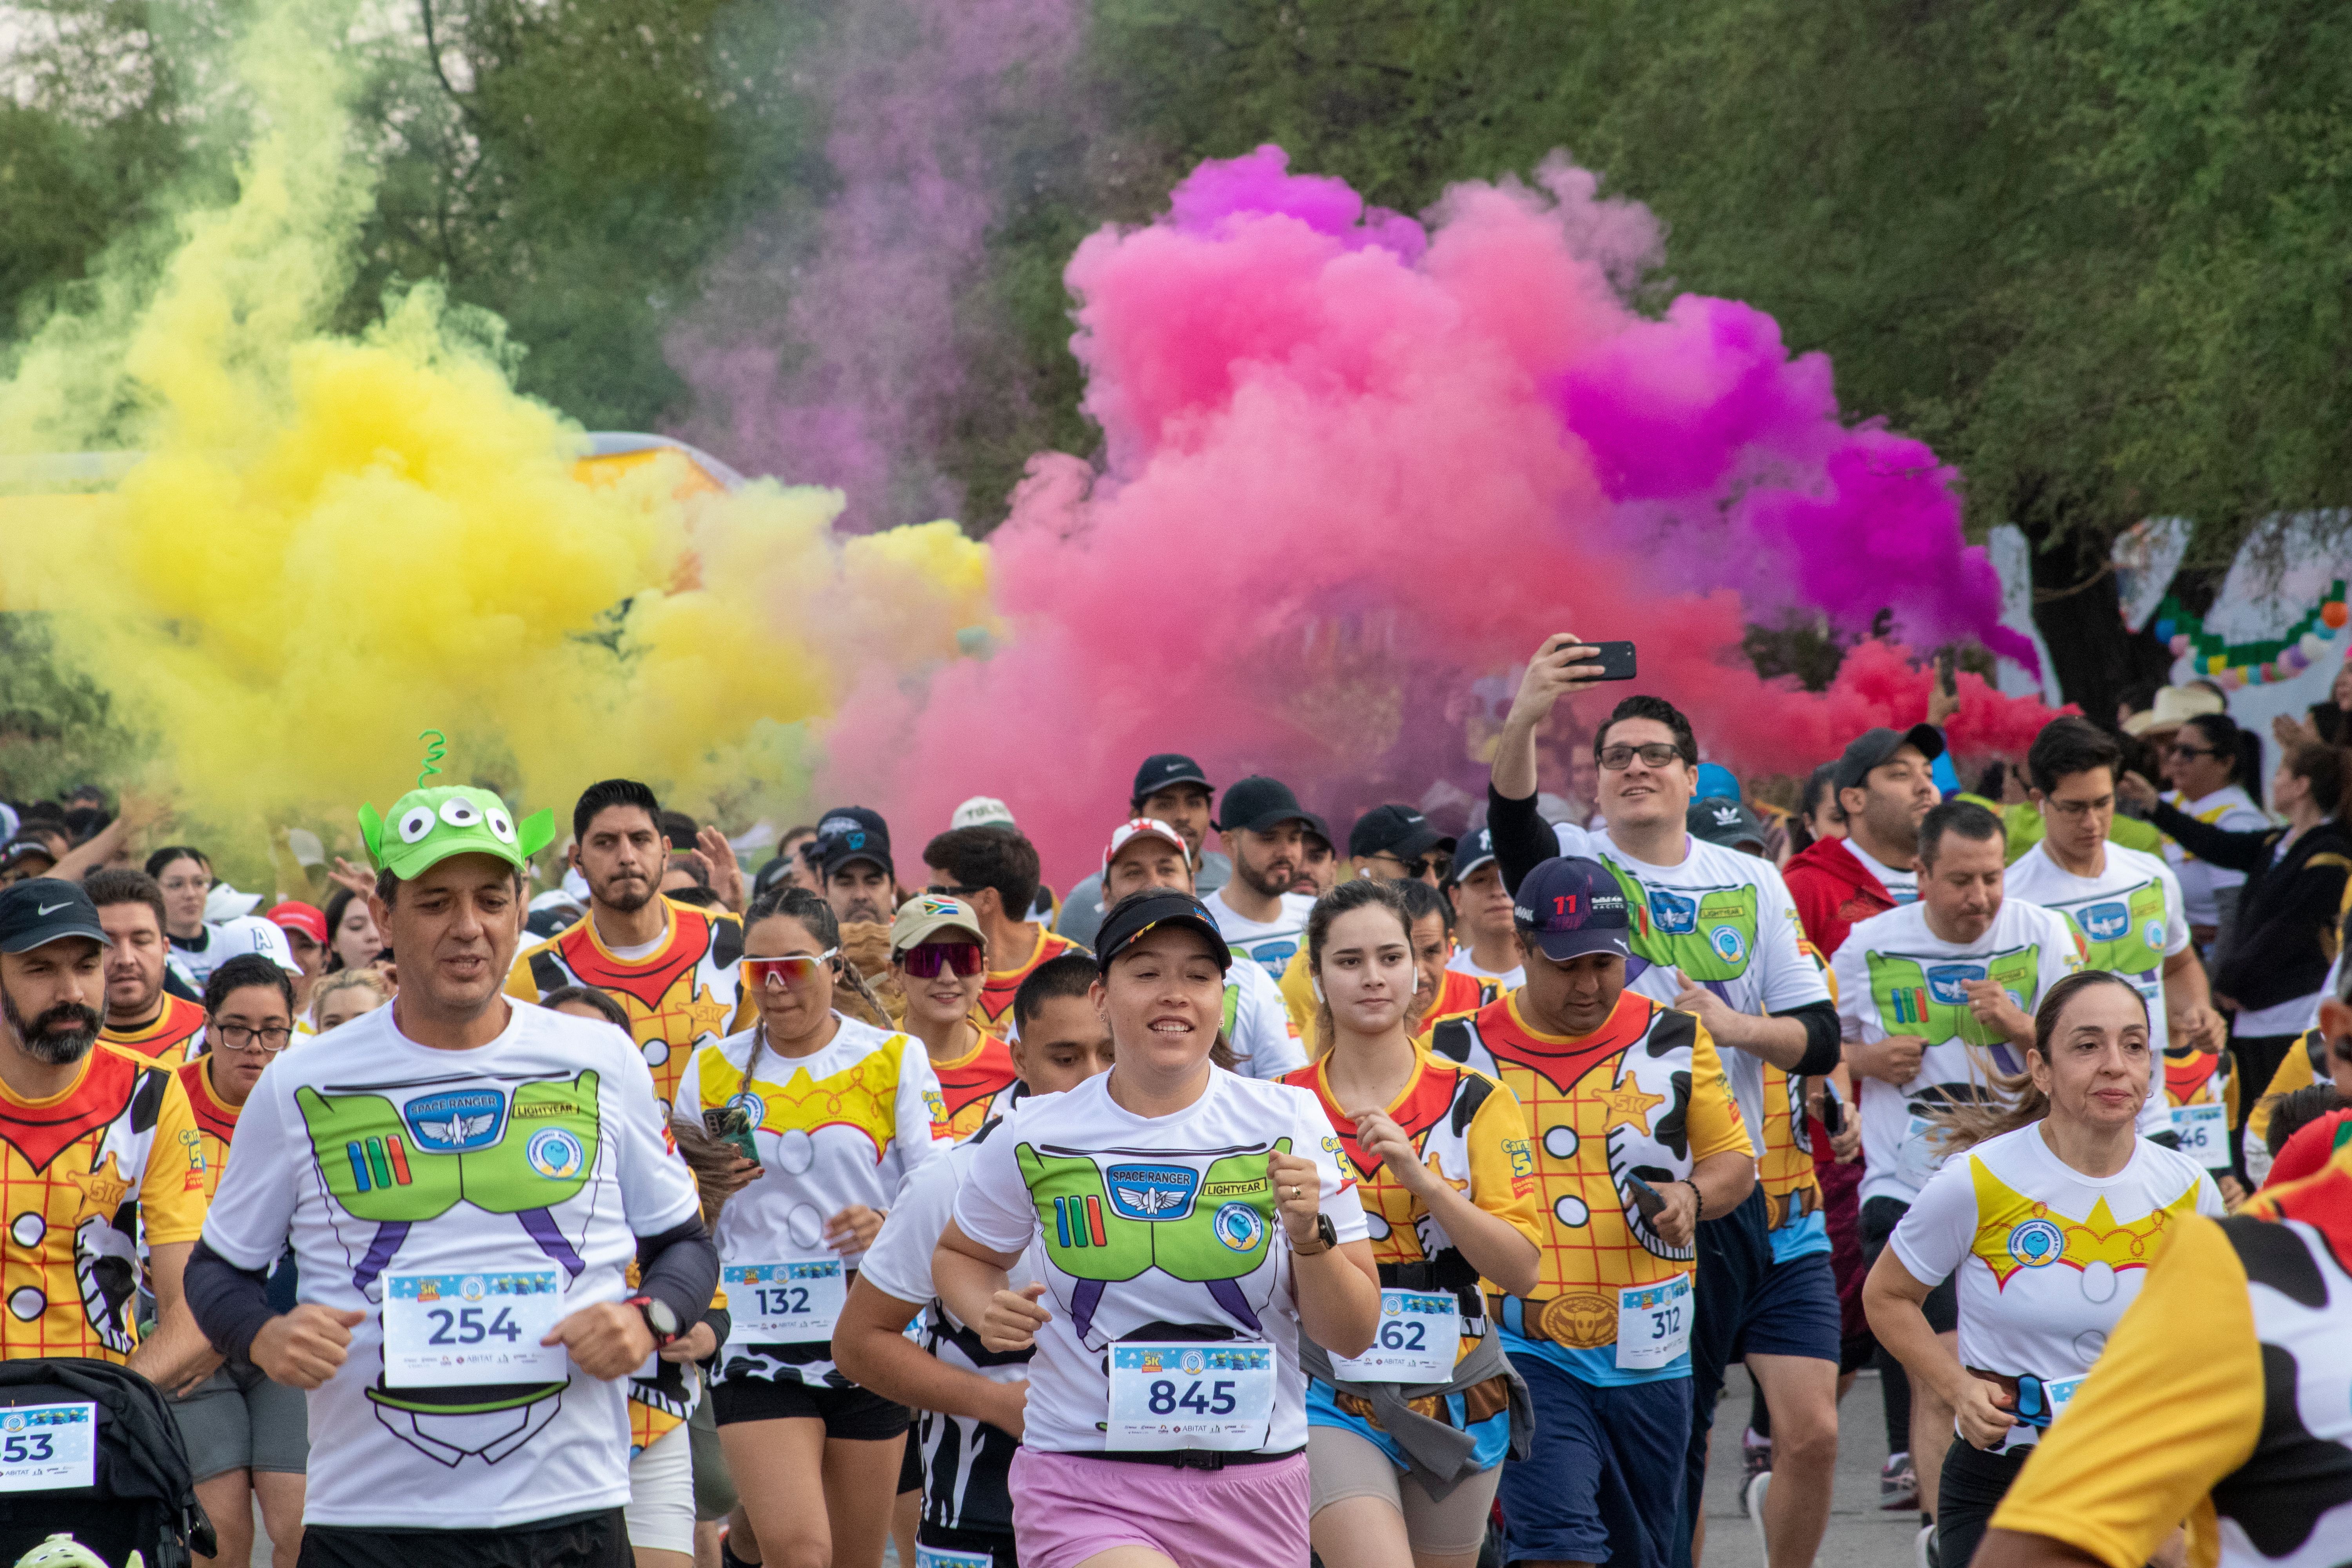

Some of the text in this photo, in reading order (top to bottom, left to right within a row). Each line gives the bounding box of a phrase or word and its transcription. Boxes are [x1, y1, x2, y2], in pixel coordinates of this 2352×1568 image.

[1553, 895, 1577, 915] 11
[250, 927, 274, 950] A
[695, 1006, 721, 1023] 5K
[410, 1095, 497, 1114] SPACE RANGER
[518, 1105, 572, 1117] LIGHTYEAR
[1614, 1094, 1648, 1115] 5K
[1334, 1149, 1357, 1181] 5
[1112, 1171, 1191, 1185] SPACE RANGER
[1207, 1182, 1261, 1195] LIGHTYEAR
[89, 1180, 125, 1206] 5K
[755, 1287, 811, 1315] 132
[427, 1307, 521, 1345] 254
[1651, 1306, 1680, 1339] 312
[1369, 1320, 1426, 1351] 62
[466, 1354, 493, 1364] ABITAT
[1144, 1356, 1160, 1366] 5K
[1148, 1380, 1236, 1415] 845
[0, 1433, 53, 1463] 53
